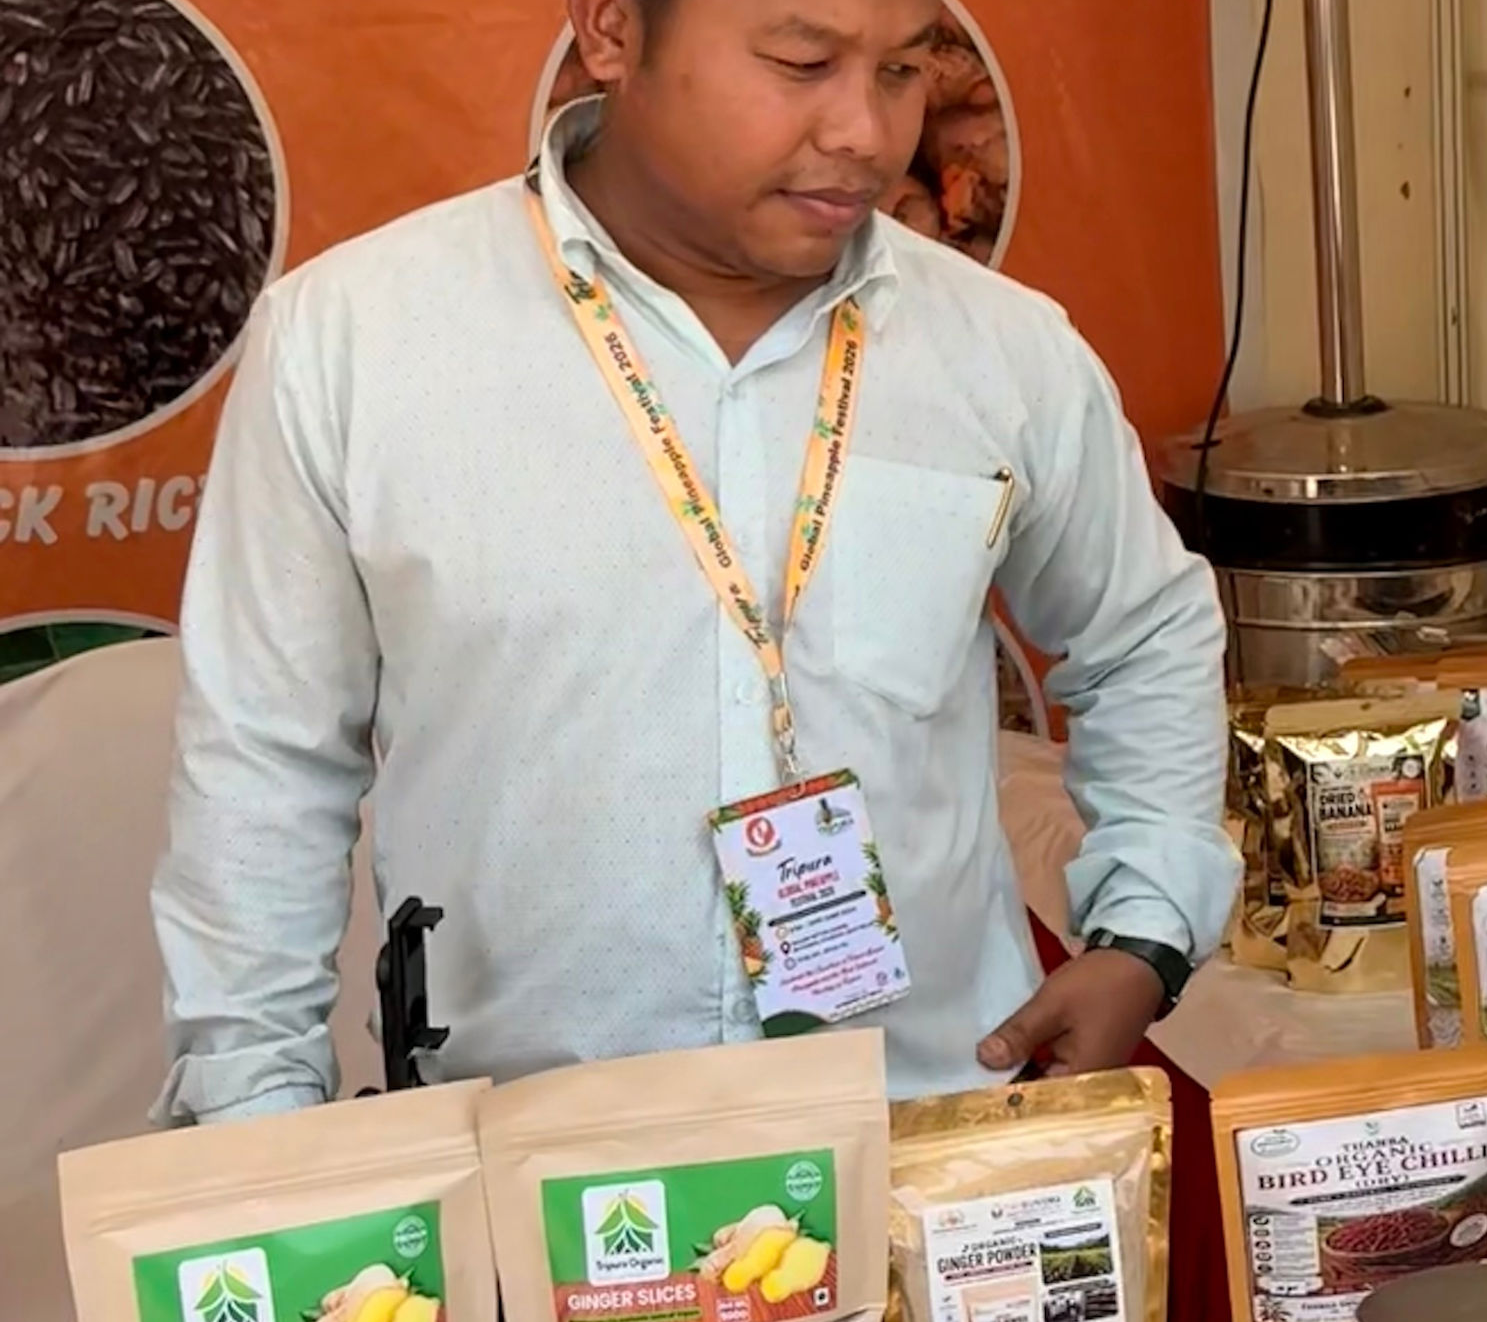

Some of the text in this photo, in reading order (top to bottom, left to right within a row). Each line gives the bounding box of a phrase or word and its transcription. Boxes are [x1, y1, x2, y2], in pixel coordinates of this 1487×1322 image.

[604, 331, 633, 372] 2026
[86, 475, 207, 543] RIC
[1319, 792, 1356, 806] DRIED
[1315, 1141, 1434, 1168] ORGANIC
[1257, 1168, 1328, 1191] BIRD
[1339, 1159, 1392, 1180] EYE
[937, 1252, 985, 1276] GINGER
[986, 1244, 1038, 1268] POWDER
[567, 1284, 696, 1312] GINGER SLICES
